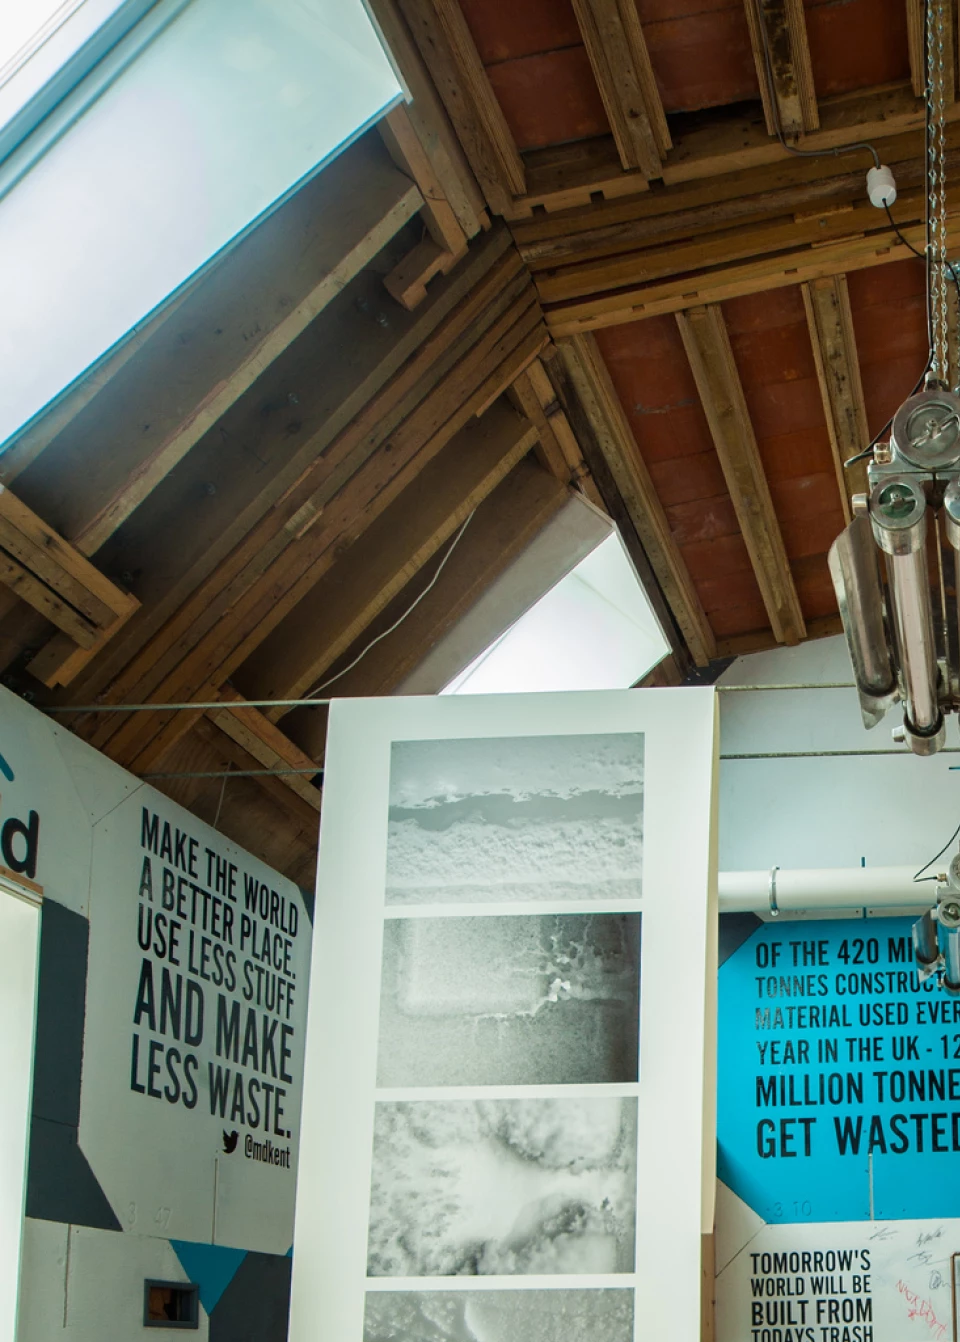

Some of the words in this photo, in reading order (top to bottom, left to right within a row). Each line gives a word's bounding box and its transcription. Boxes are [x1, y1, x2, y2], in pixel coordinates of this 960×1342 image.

[141, 806, 199, 879] MAKE
[205, 847, 238, 903] THE
[244, 871, 298, 938] WORLD
[139, 856, 153, 902] A
[162, 866, 234, 945] BETTER
[240, 913, 296, 980] PLACE.
[138, 903, 181, 967] USE
[188, 929, 236, 994] LESS
[242, 959, 295, 1020] STUFF
[756, 941, 782, 968] OF
[789, 940, 829, 967] THE
[837, 938, 879, 965] 420
[755, 974, 828, 998] TONNES
[133, 957, 204, 1047] AND
[216, 993, 294, 1084] MAKE
[755, 1004, 852, 1030] MATERIAL
[860, 1002, 908, 1026] USED
[756, 1039, 809, 1065] YEAR
[818, 1038, 838, 1063] IN
[845, 1037, 884, 1062] THE
[892, 1035, 920, 1060] UK
[131, 1033, 199, 1109] LESS
[208, 1061, 291, 1139] WASTE.
[756, 1072, 863, 1107] MILLION
[244, 1133, 290, 1169] @mdkent
[756, 1117, 816, 1159] GET
[750, 1248, 871, 1275] TOMORROW'S
[750, 1277, 805, 1297] WORLD
[810, 1275, 847, 1295] WILL
[852, 1274, 872, 1294] BE
[751, 1299, 809, 1326] BUILT
[816, 1297, 872, 1324] FROM
